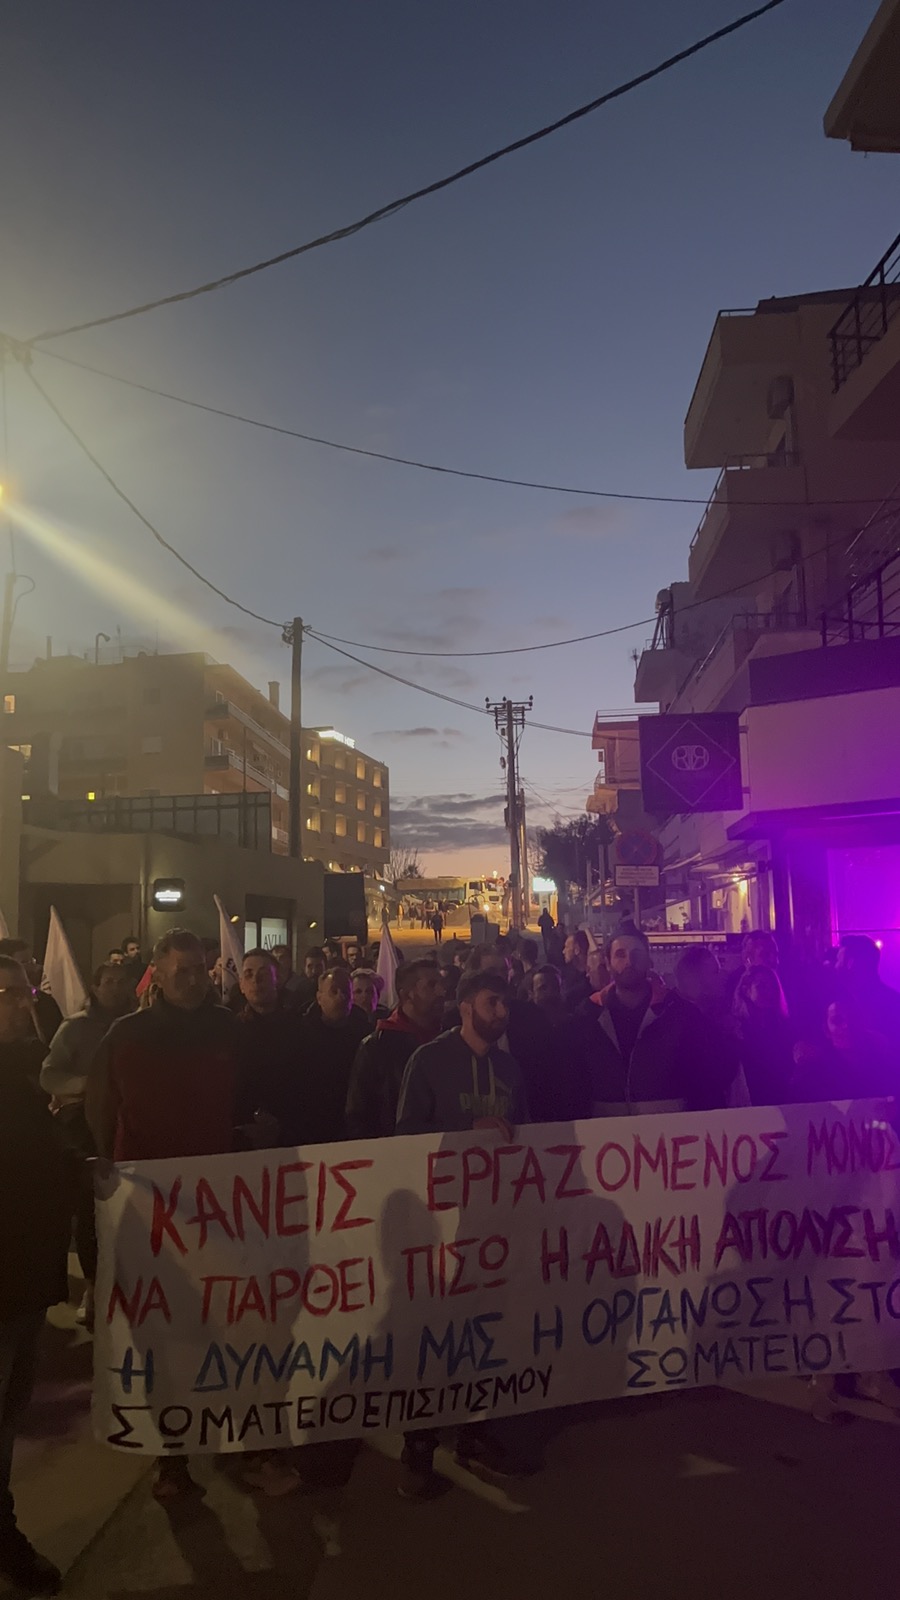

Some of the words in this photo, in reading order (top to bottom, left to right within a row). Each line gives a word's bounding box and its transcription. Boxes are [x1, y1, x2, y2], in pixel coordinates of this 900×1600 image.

[150, 1159, 374, 1256] ΚΑΝΕΙΣ
[427, 1132, 788, 1210] ΕΡΓΑΖΟΜΕΝΟΣ
[106, 1277, 170, 1326] ΝΑ
[200, 1257, 375, 1325] ΠΑΡΘΕΙ
[401, 1236, 510, 1300] ΠΙΣΩ
[541, 1226, 569, 1283] Η
[582, 1213, 700, 1283] ΑΔΙΚΗ
[714, 1205, 900, 1271] ΑΠΟΛΥΣΗ
[108, 1347, 155, 1393] Η
[192, 1332, 393, 1392] ΔΥΝΑΜΗ
[417, 1311, 507, 1381] ΜΑΣ
[533, 1305, 563, 1356] Η
[582, 1276, 815, 1345] ΟΡΓΑΝΩΣΗ
[627, 1331, 851, 1388] ΣΩΜΑΤΕΙΟ!
